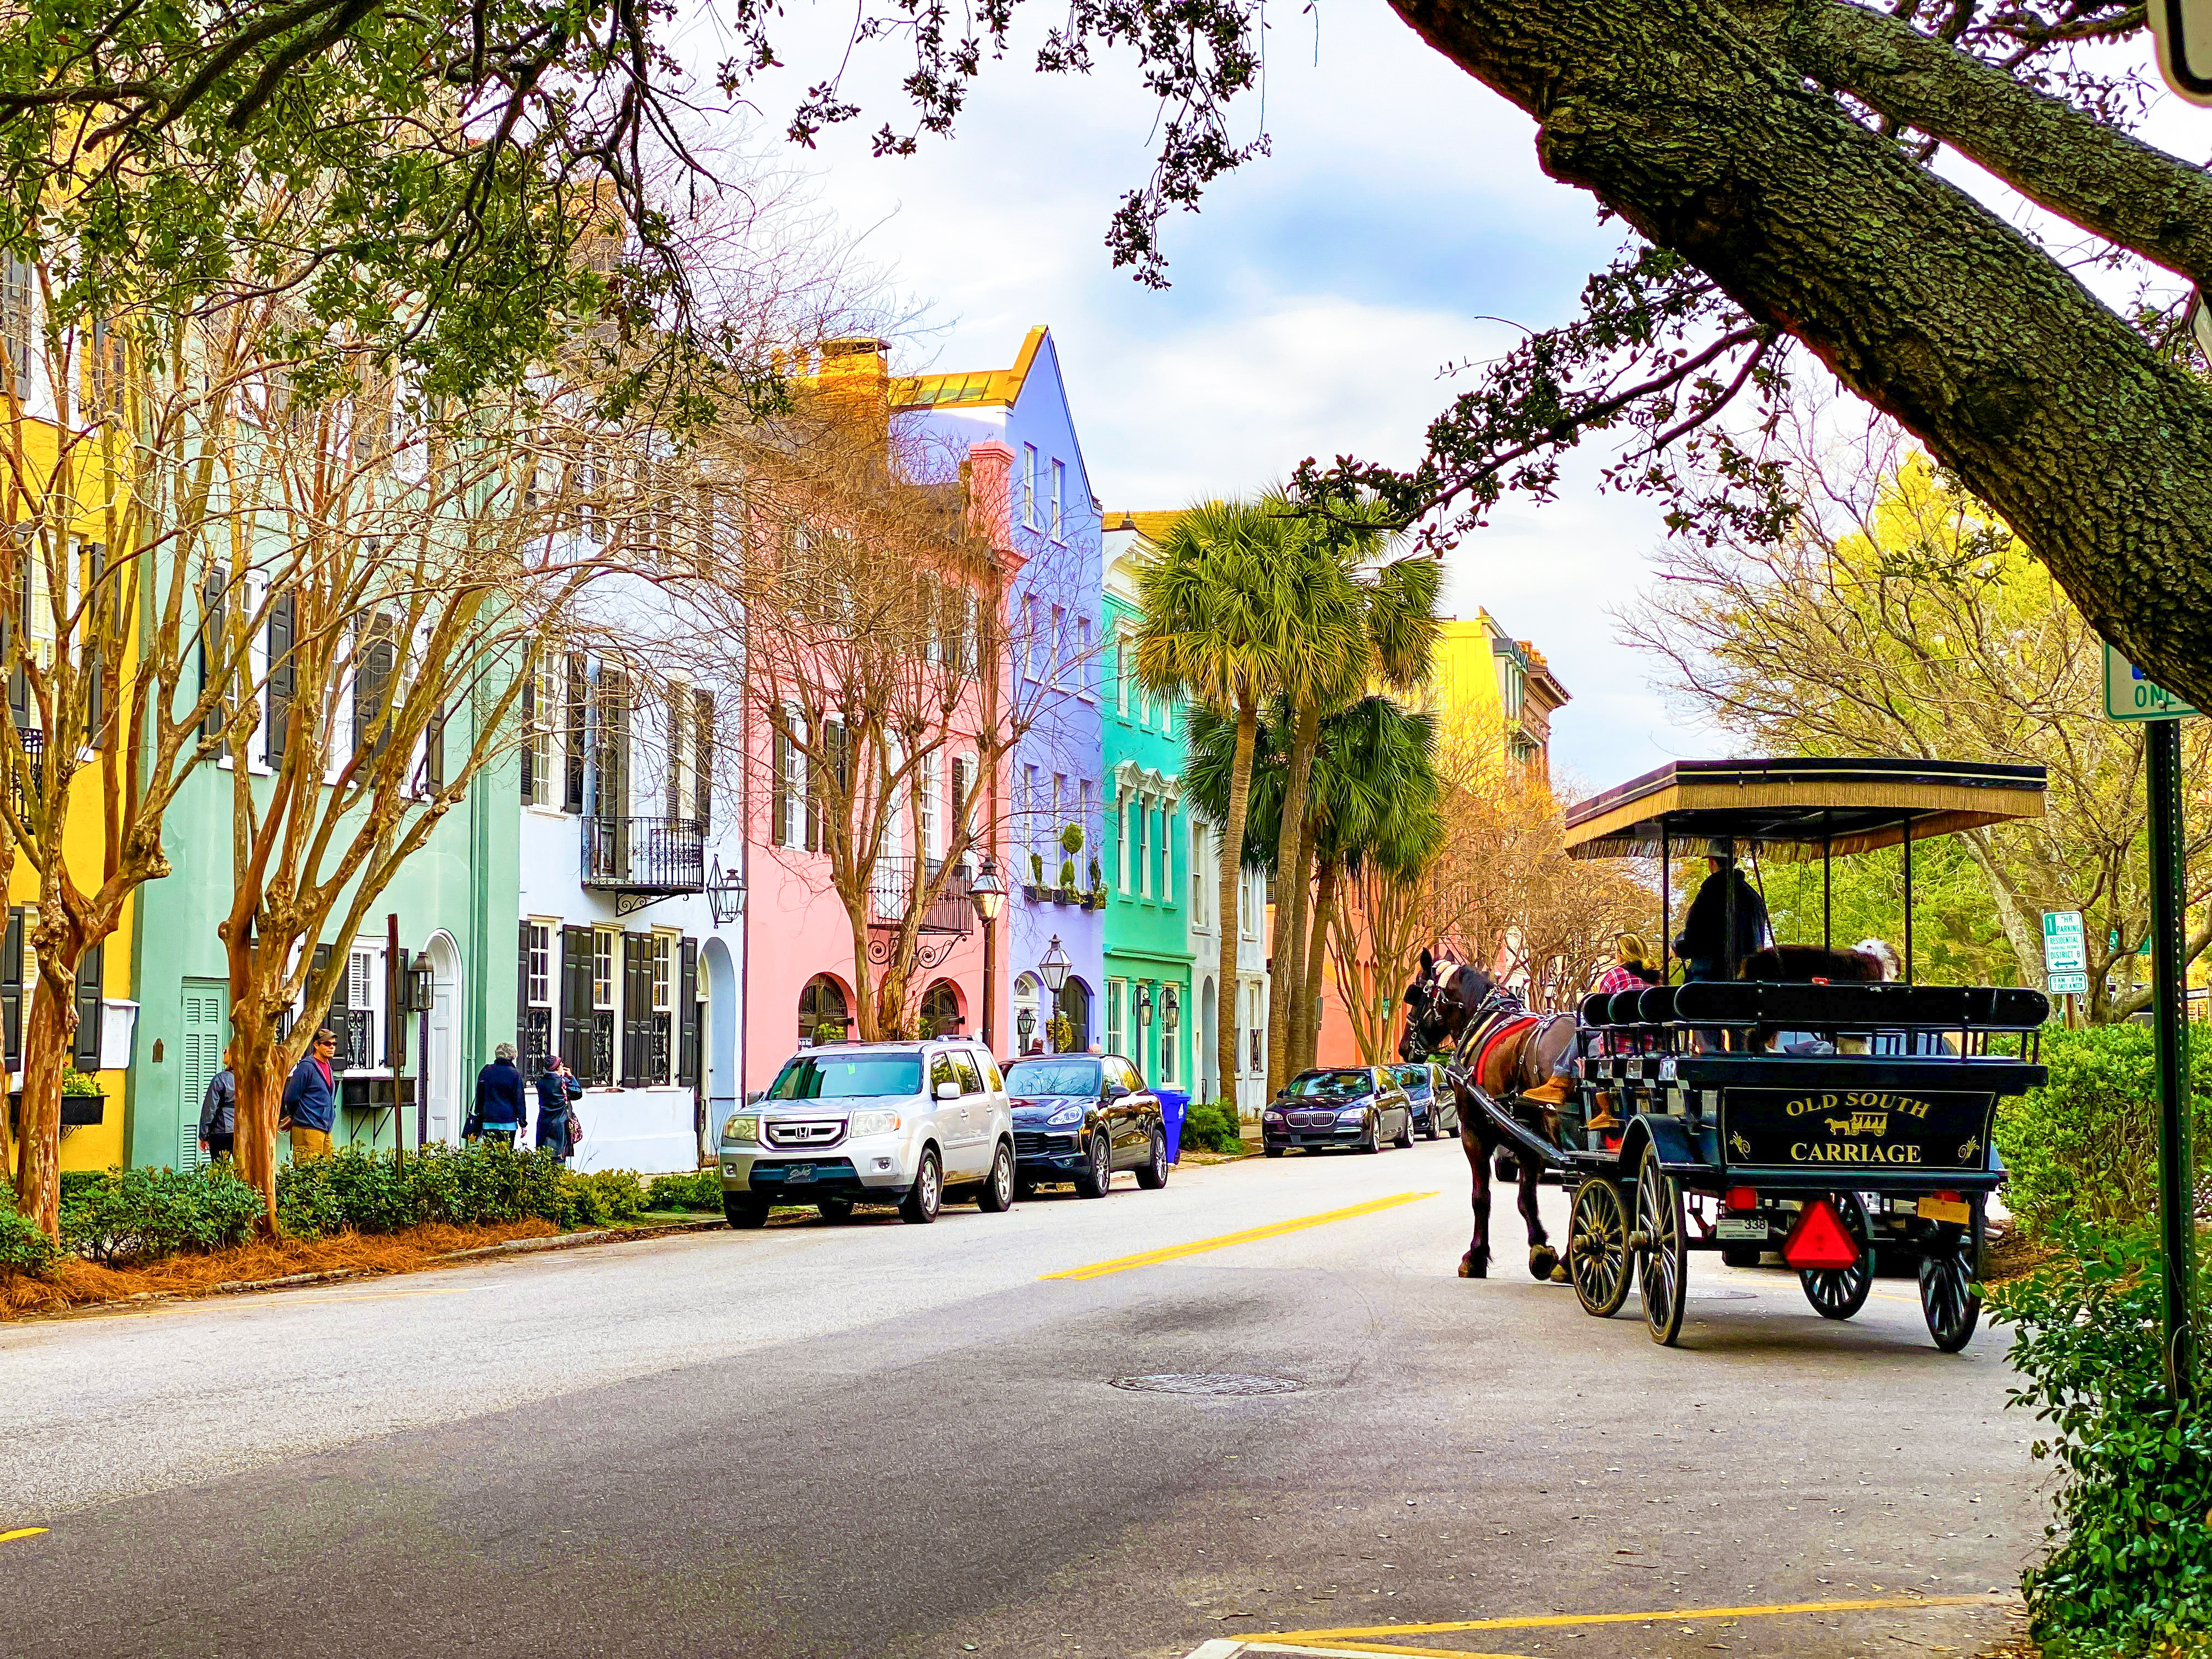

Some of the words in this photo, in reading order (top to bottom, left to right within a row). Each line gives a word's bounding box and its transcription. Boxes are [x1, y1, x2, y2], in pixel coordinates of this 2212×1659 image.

[2135, 685, 2186, 708] ONL
[2047, 918, 2053, 933] 1
[2050, 936, 2079, 944] RESIDENTIAL
[2050, 951, 2073, 960] DISTRICT
[1786, 1094, 1838, 1116] OLD
[1846, 1092, 1931, 1119] SOUTH
[1791, 1142, 1922, 1163] CARRIAGE
